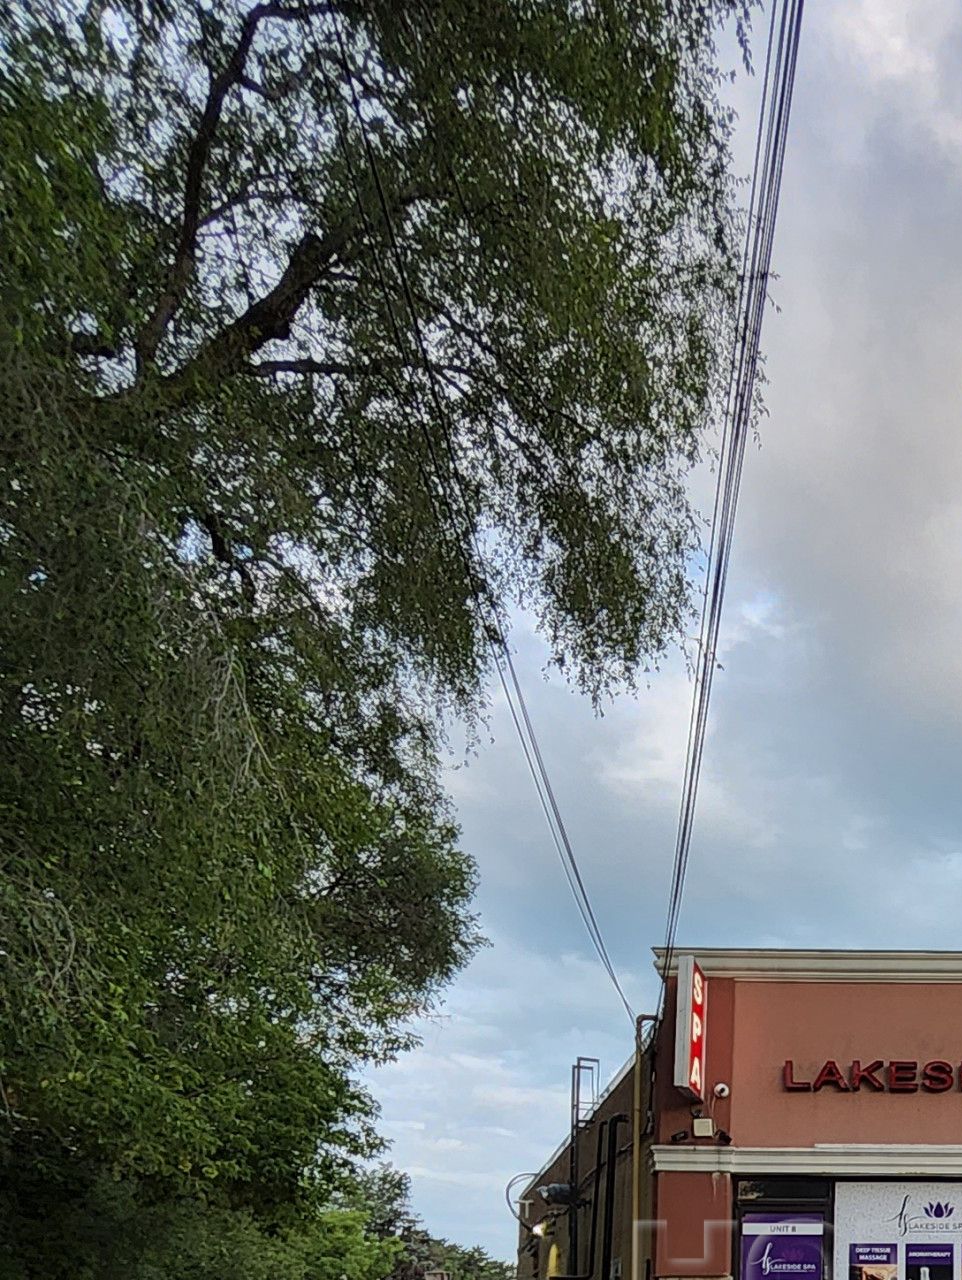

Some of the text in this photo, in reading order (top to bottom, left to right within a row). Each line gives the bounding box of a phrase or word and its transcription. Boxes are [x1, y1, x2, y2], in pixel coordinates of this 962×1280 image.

[690, 972, 704, 1091] SPA
[769, 1225, 789, 1233] UNIT
[908, 1222, 949, 1230] LAKESIDE
